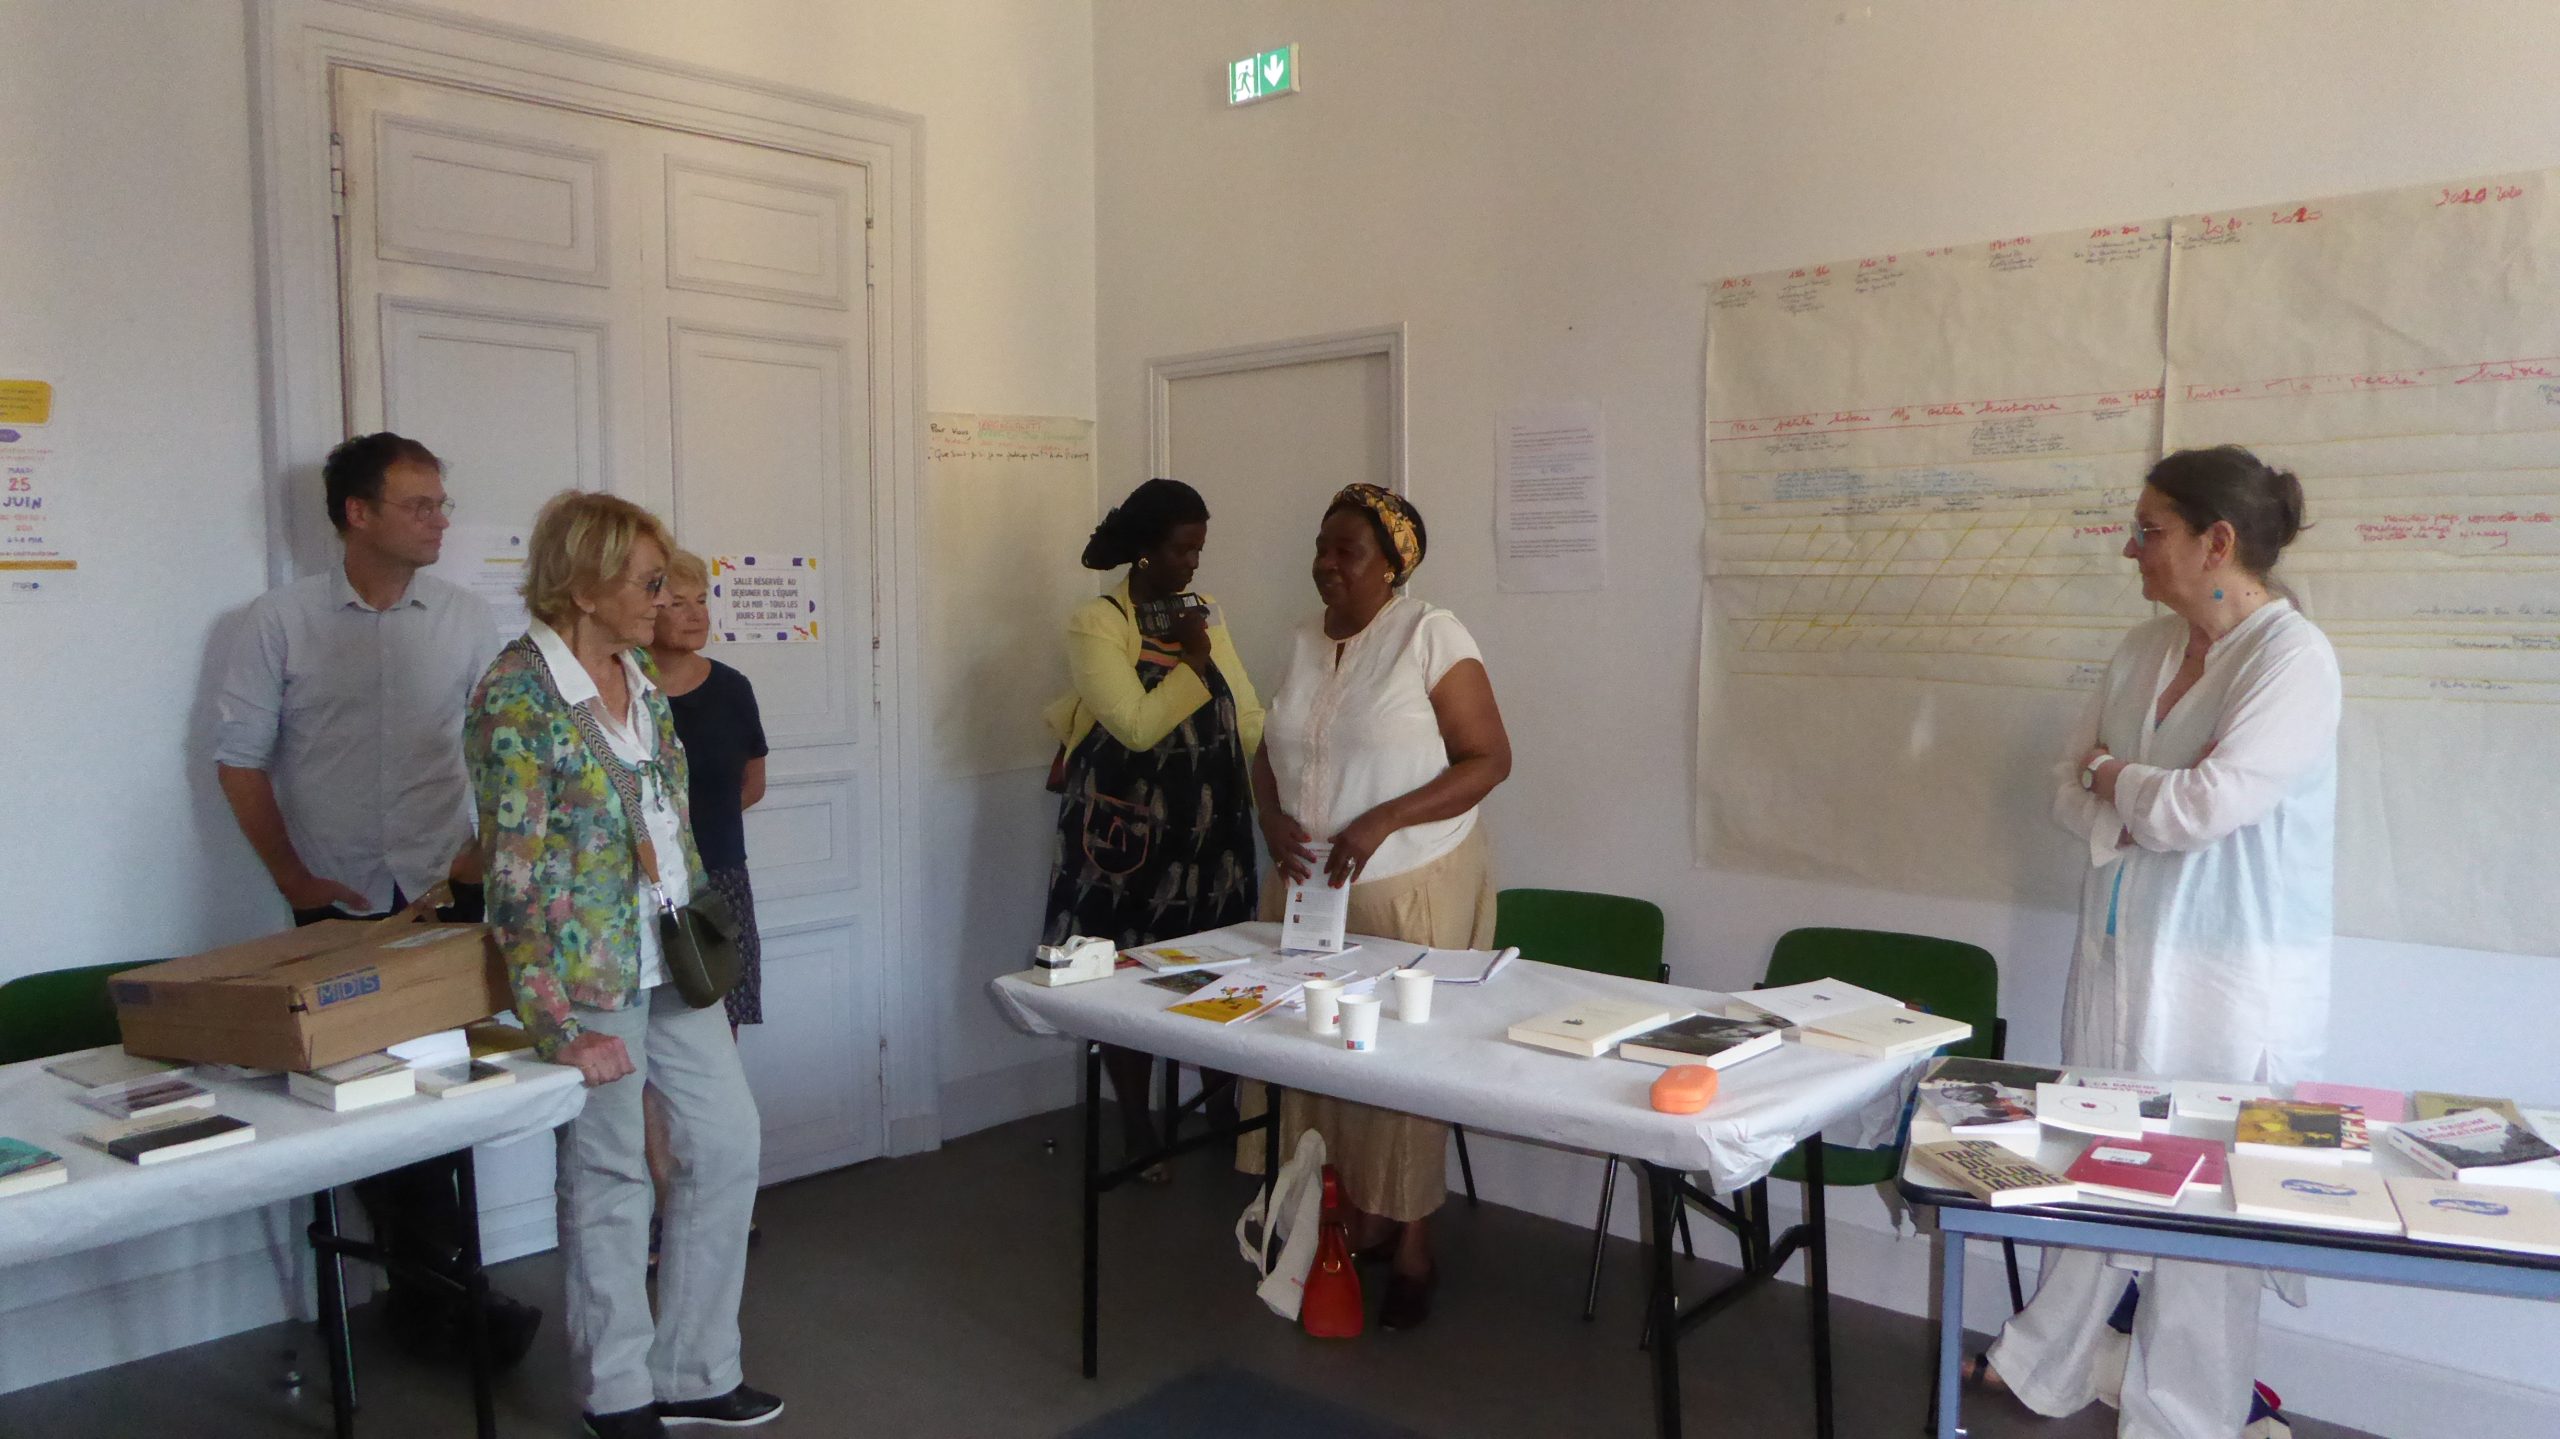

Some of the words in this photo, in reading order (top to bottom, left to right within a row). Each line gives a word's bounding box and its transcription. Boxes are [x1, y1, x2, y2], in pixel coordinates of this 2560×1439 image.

[8, 477, 31, 492] 25
[2, 496, 42, 510] JUIN
[733, 577, 752, 586] SALLE
[786, 600, 798, 608] LES
[1936, 1148, 1996, 1162] TRAIT
[1958, 1158, 1992, 1170] DU
[1967, 1164, 2042, 1180] COLON
[1983, 1173, 2065, 1191] IALISTE
